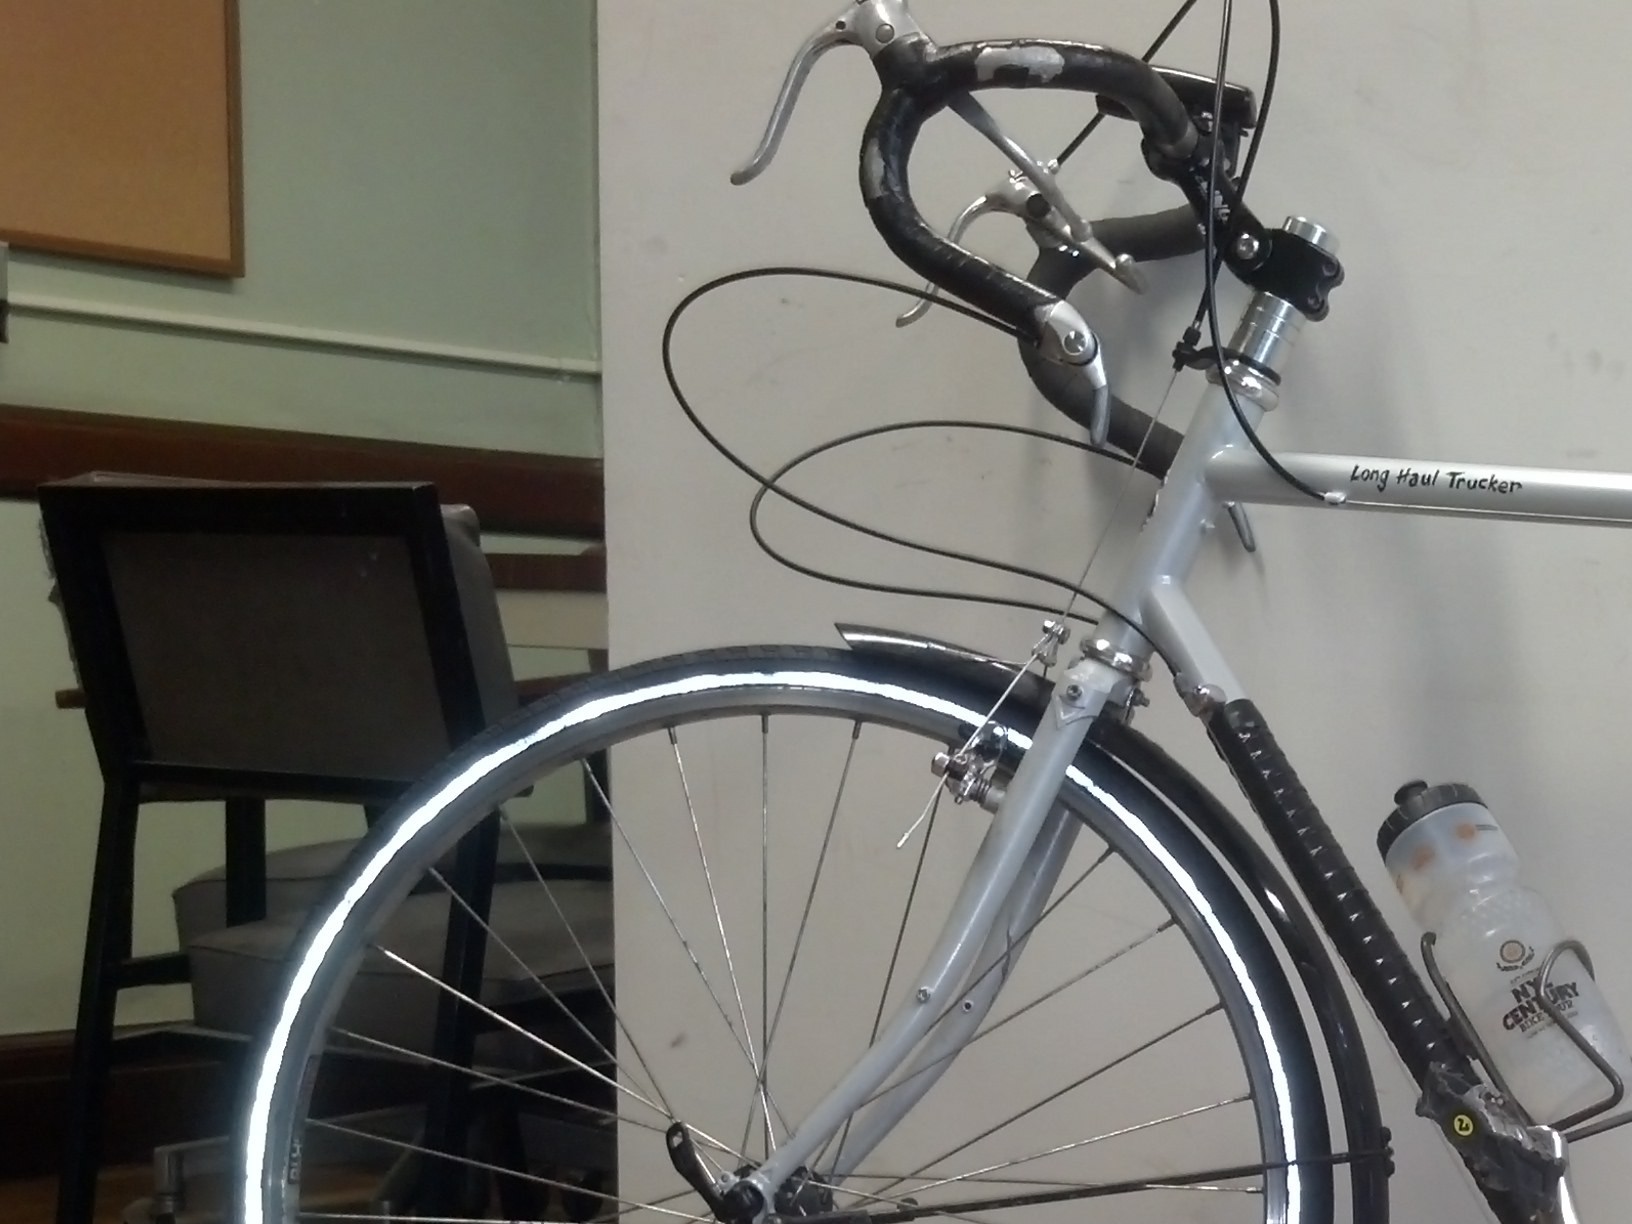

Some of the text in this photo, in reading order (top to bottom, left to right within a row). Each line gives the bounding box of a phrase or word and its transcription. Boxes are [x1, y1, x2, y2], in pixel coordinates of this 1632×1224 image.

[1351, 464, 1522, 494] Long Haul Trucker
[1511, 975, 1554, 1004] NY
[1519, 1011, 1545, 1033] BIKE
